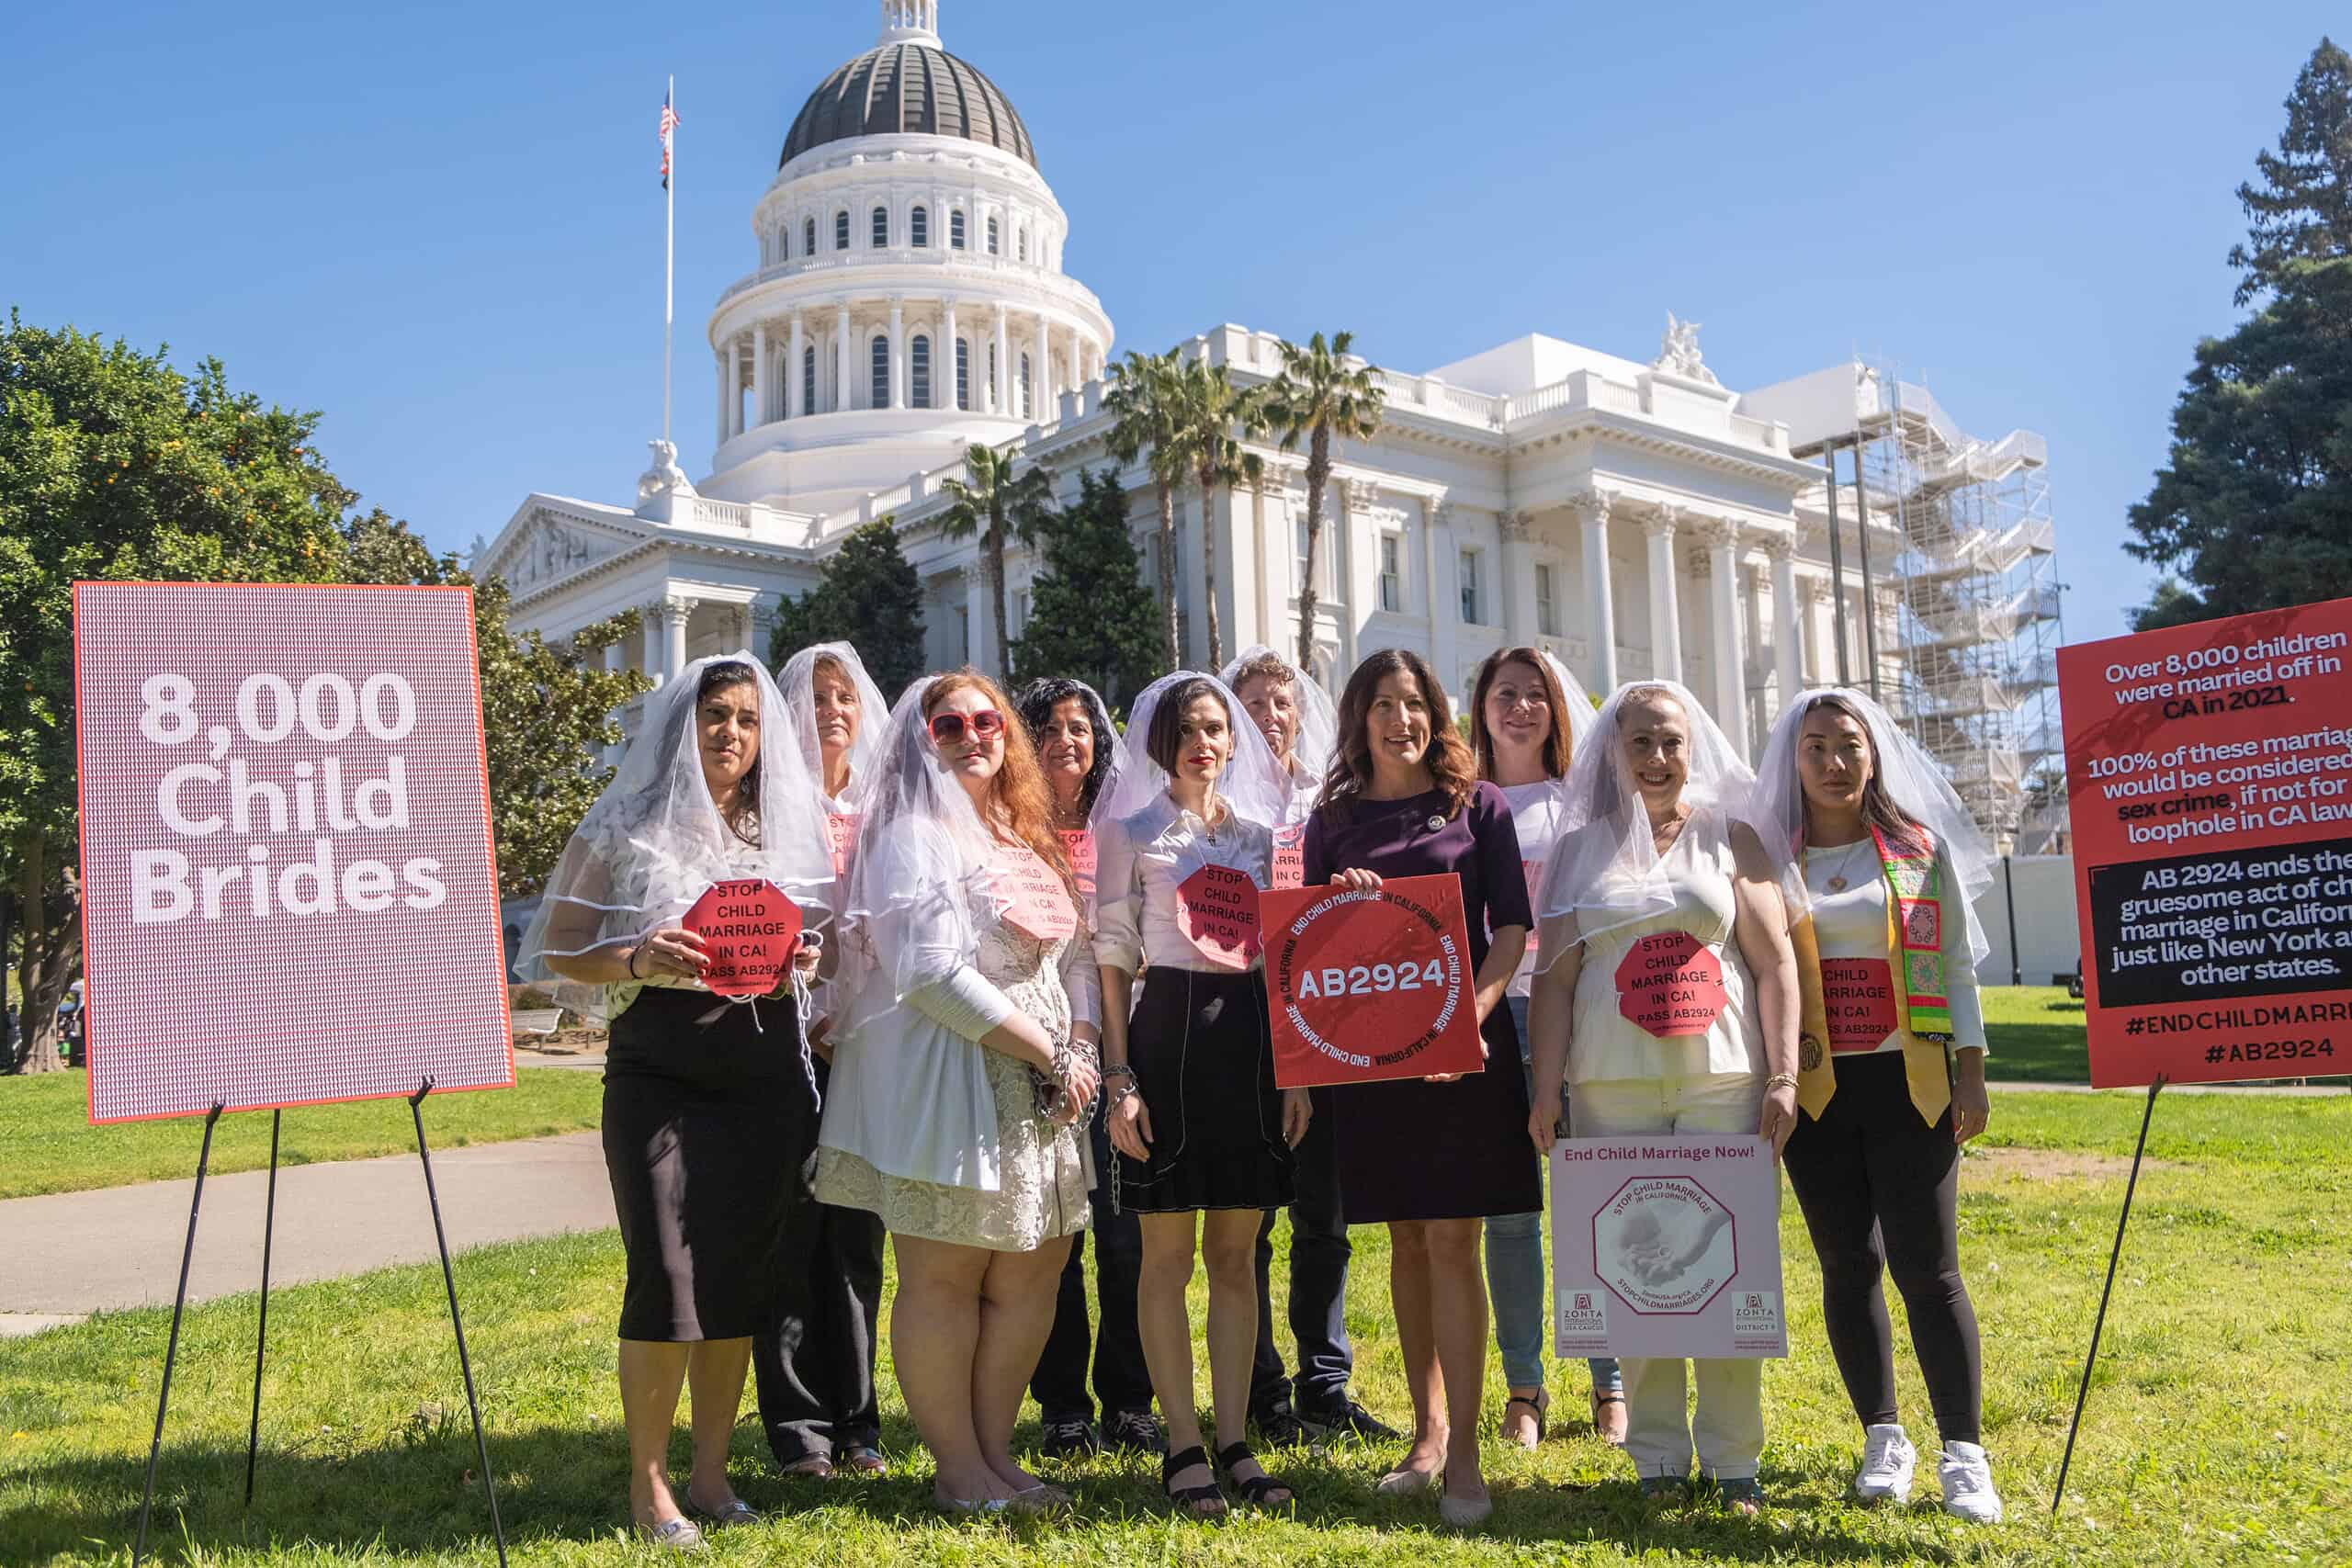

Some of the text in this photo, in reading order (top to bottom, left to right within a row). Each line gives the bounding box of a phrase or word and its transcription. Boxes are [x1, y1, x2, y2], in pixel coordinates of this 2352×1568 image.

[2106, 631, 2347, 683] Over 8,000 children
[2115, 654, 2342, 705] were married off in
[2163, 684, 2296, 719] CA in 2021.
[140, 673, 416, 761] 8,000
[2087, 750, 2157, 779] 100%
[2161, 745, 2188, 768] of
[2188, 739, 2258, 765] these
[2102, 773, 2175, 800] would
[2181, 768, 2212, 788] be
[156, 756, 410, 837] Child
[2118, 776, 2347, 821] sex crime, if not for
[2128, 818, 2235, 846] loophole
[2239, 812, 2264, 831] in
[2268, 804, 2307, 829] CA
[130, 839, 447, 924] Brides
[1206, 869, 1243, 885] STOP
[1276, 871, 1288, 881] IN
[2142, 870, 2178, 891] AB
[2181, 861, 2244, 886] 2924
[2247, 853, 2312, 879] ends
[718, 884, 763, 897] STOP
[1204, 887, 1240, 905] CHILD
[2120, 889, 2243, 922] gruesome
[2247, 884, 2289, 903] act
[2291, 876, 2321, 899] of
[717, 904, 765, 919] CHILD
[1189, 901, 1254, 925] MARRIAGE
[1291, 890, 1442, 935] END CHILD MARRIAGE IN CALIFORNIA
[699, 921, 786, 938] MARRIAGE
[1204, 923, 1239, 941] IN CA!
[2120, 916, 2230, 942] marriage
[2233, 909, 2257, 930] in
[719, 944, 767, 959] IN CA!
[1643, 937, 1684, 953] STOP
[2111, 947, 2157, 972] just
[2161, 940, 2203, 963] like
[2209, 938, 2266, 958] New
[2269, 927, 2333, 952] York
[709, 964, 787, 978] ASS AB2924
[1645, 954, 1690, 970] CHILD
[2181, 957, 2341, 986] other states.
[1299, 959, 1445, 999] AB2924
[1632, 971, 1709, 990] MARRIAGE
[1823, 969, 1868, 982] CHILD
[1279, 939, 1370, 1066] END CHILD MARRIAGE IN CALIFORNIA
[1375, 934, 1461, 1066] END CHILD MARRIAGE IN CALIFORNIA
[1652, 991, 1696, 1005] IN CA!
[1824, 987, 1887, 999] RRIAGE
[1637, 1008, 1715, 1022] PASS AB2924
[1844, 1006, 1870, 1018] CA!
[1844, 1023, 1889, 1034] AB2924
[2205, 1039, 2334, 1064] #AB2924
[1565, 1145, 1755, 1162] End Child Marriage Now!
[1613, 1181, 1713, 1215] STOP CHILD MARRIAGE
[1645, 1192, 1687, 1202] CALIFORNIA
[1565, 1310, 1603, 1318] ZONTA
[1736, 1308, 1775, 1316] ZONTA
